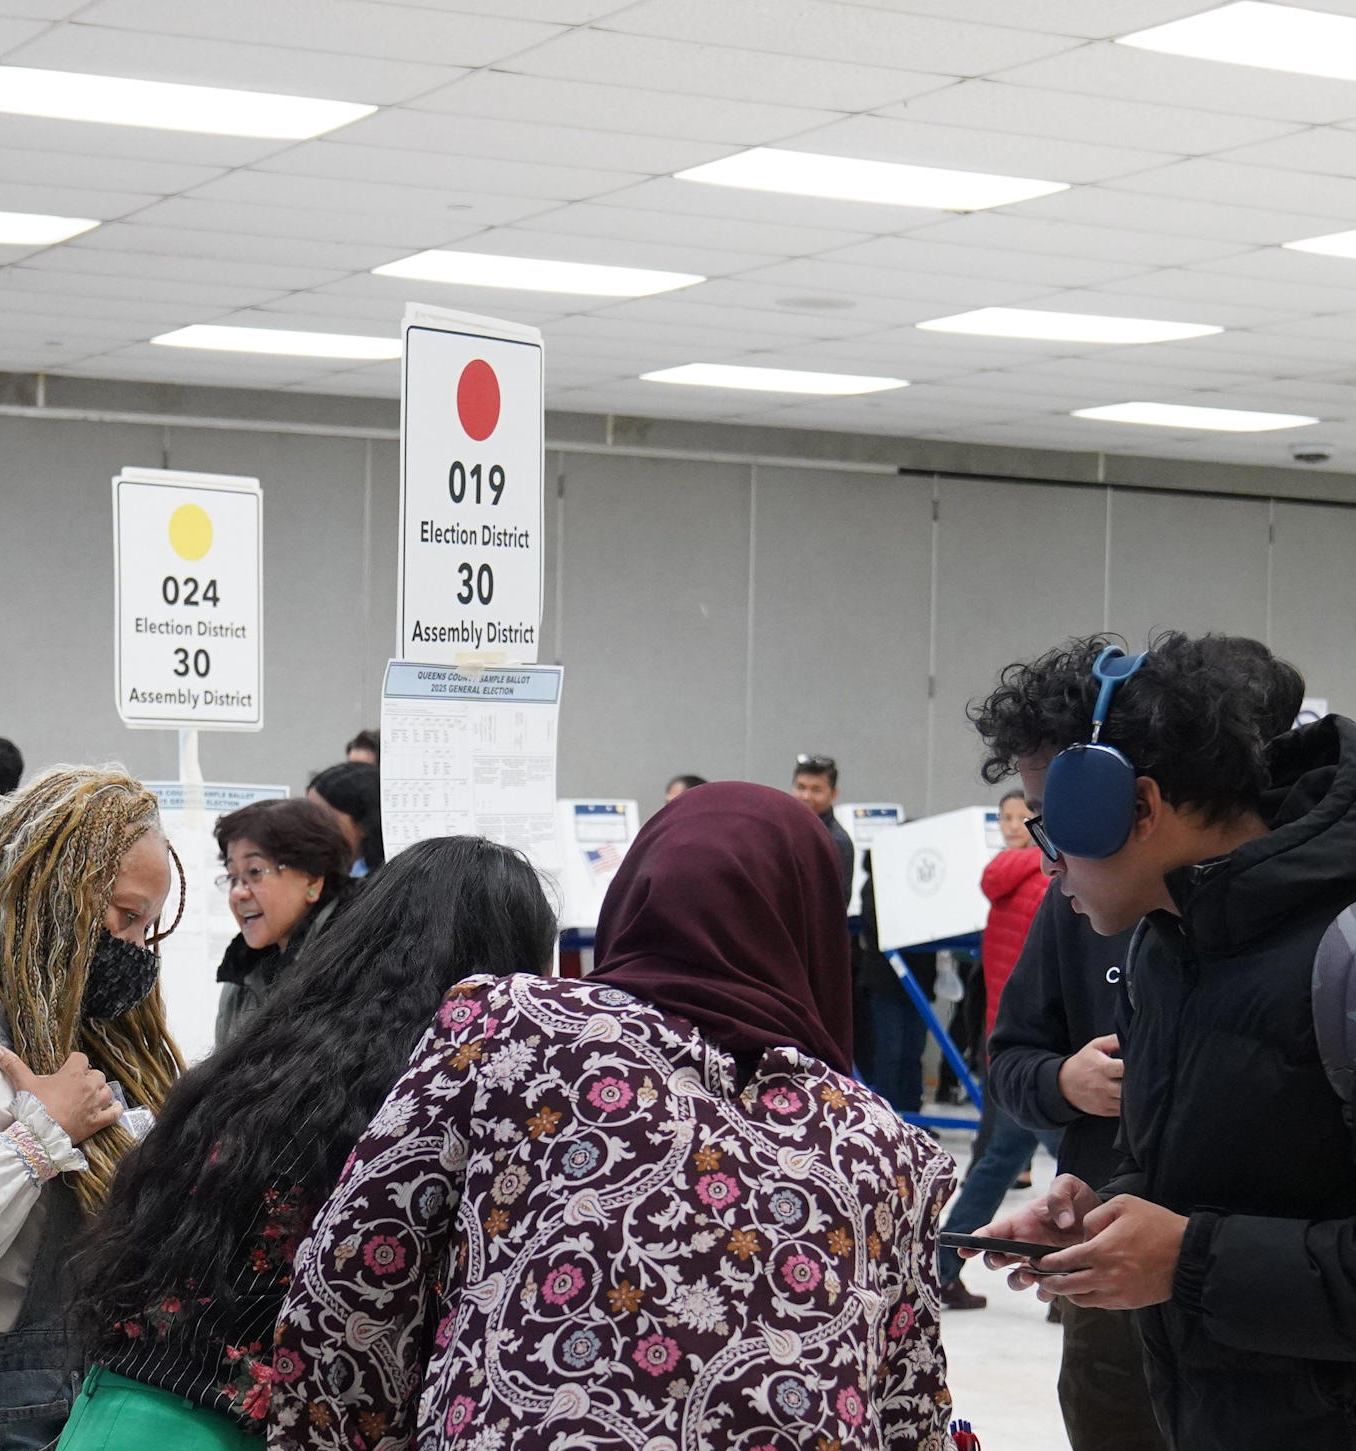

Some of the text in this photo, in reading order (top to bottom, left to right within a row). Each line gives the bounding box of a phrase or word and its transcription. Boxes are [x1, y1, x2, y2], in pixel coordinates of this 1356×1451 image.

[448, 460, 506, 506] 019
[420, 520, 530, 549] Election District
[162, 575, 220, 608] 024
[456, 562, 494, 606] 30
[134, 617, 247, 639] Election District
[411, 619, 535, 650] Assembly District
[173, 647, 211, 678] 30
[417, 670, 446, 681] QUEENS
[505, 675, 531, 685] BALLOT
[129, 687, 253, 710] Assembly District
[430, 683, 515, 696] 2025 GENERAL ELECTION
